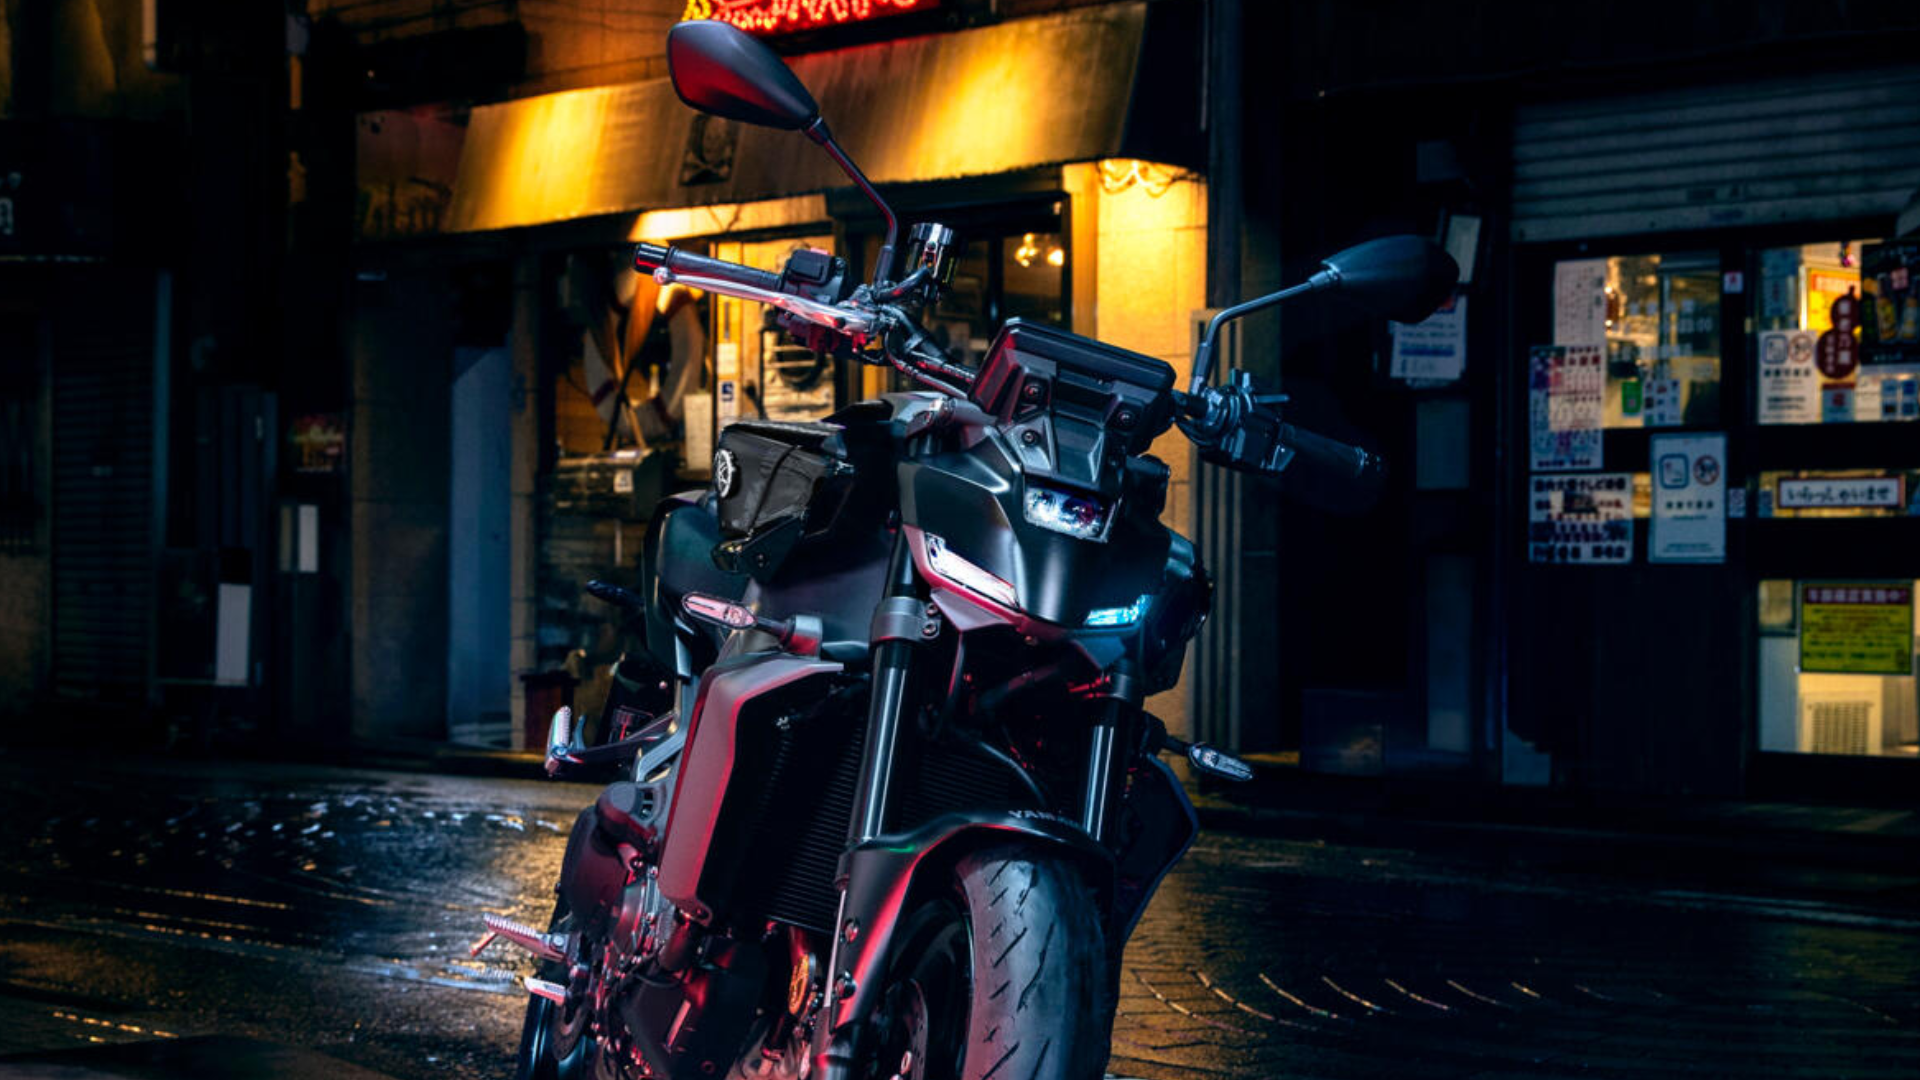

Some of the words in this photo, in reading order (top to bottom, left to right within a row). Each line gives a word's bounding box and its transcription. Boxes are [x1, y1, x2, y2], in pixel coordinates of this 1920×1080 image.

[1787, 484, 1889, 504] いらっしゃいませ
